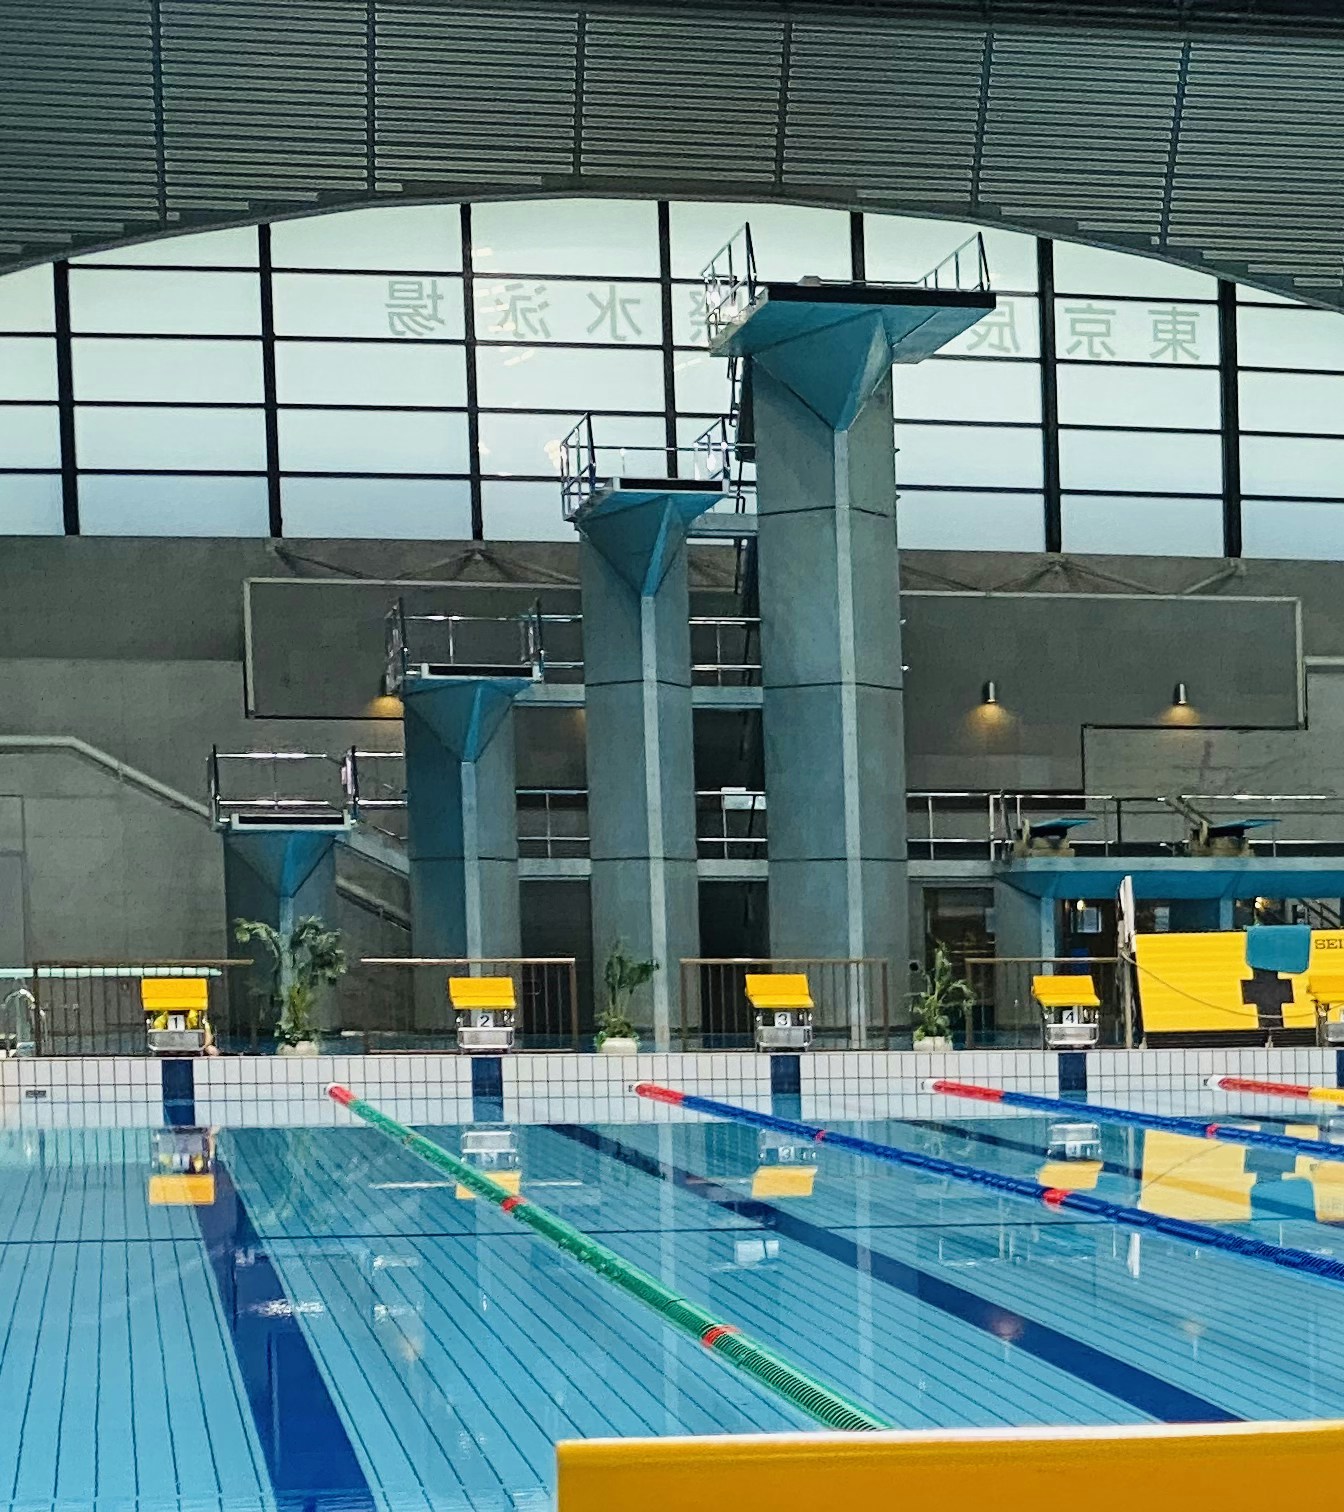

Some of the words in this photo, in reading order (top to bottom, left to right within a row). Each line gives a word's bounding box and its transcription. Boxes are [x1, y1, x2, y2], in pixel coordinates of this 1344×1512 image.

[480, 1015, 490, 1027] 2
[778, 1013, 788, 1026] 3
[1065, 1011, 1074, 1024] 4
